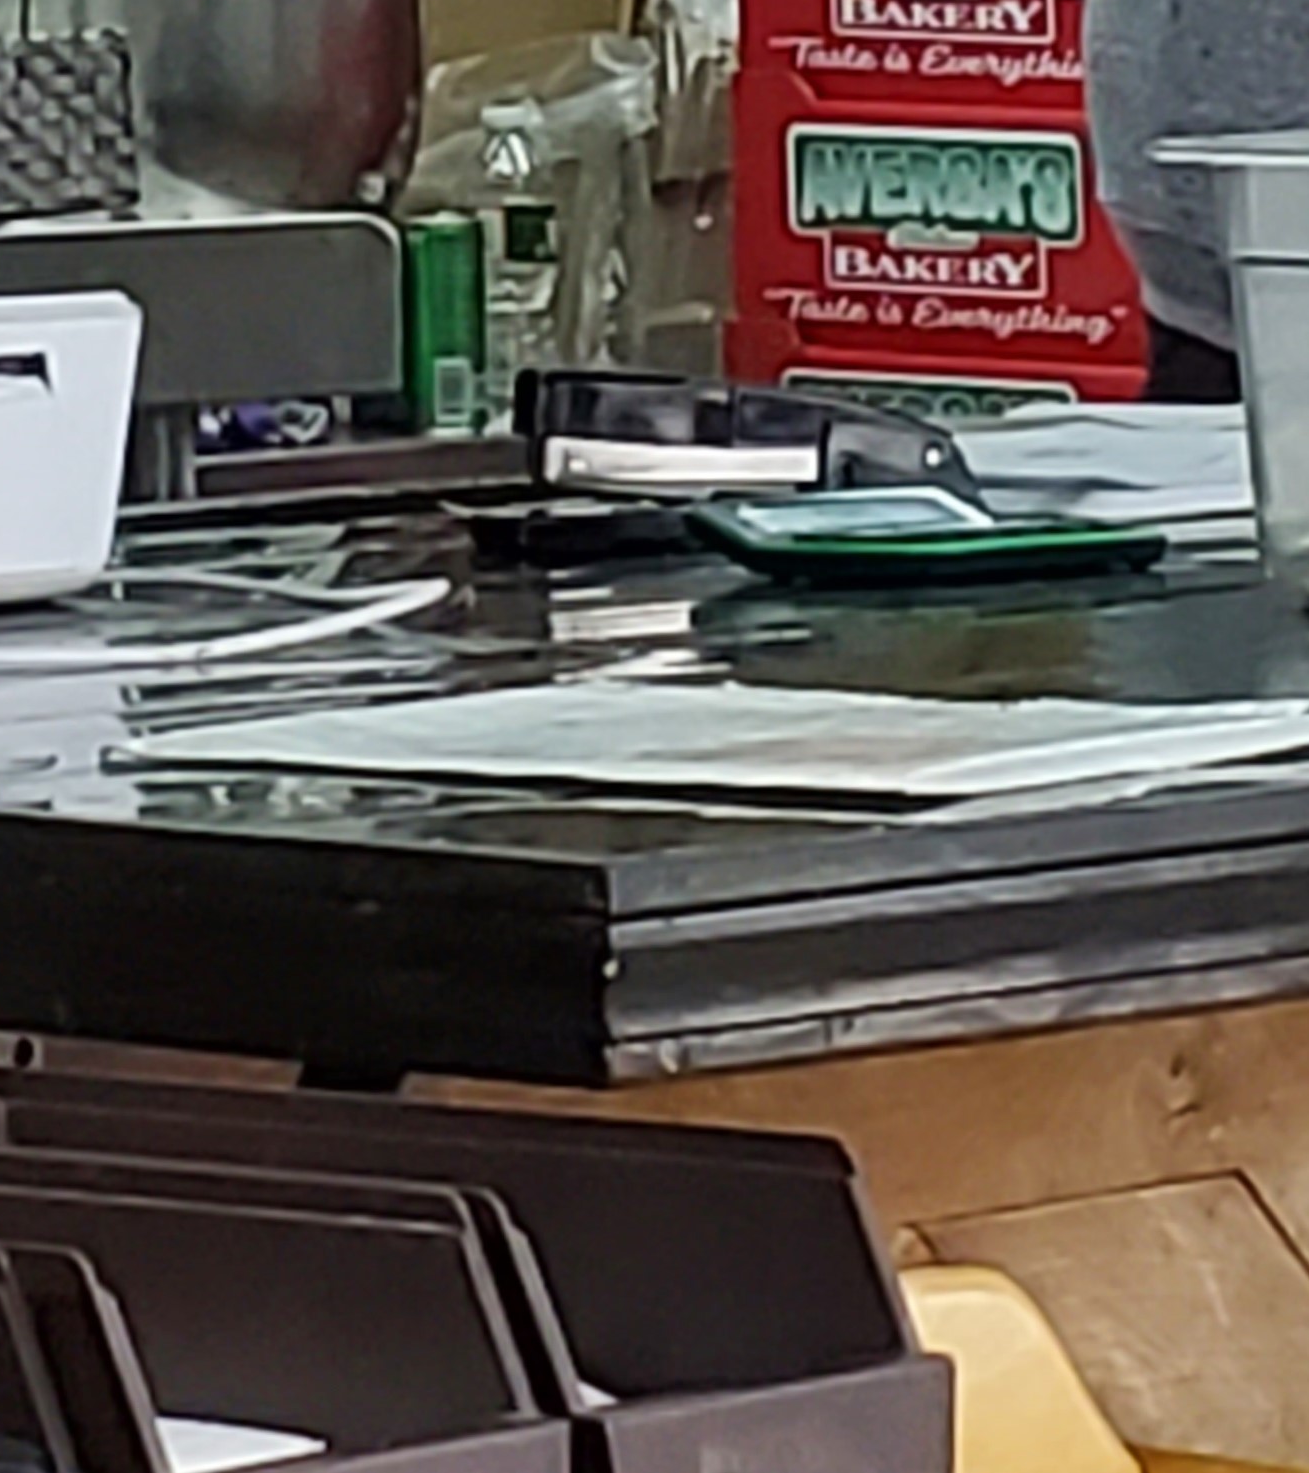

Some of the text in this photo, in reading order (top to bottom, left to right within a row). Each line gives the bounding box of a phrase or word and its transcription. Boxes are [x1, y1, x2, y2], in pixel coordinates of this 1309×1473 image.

[884, 43, 912, 73] is
[834, 244, 1034, 287] BAKERY
[876, 294, 904, 325] is
